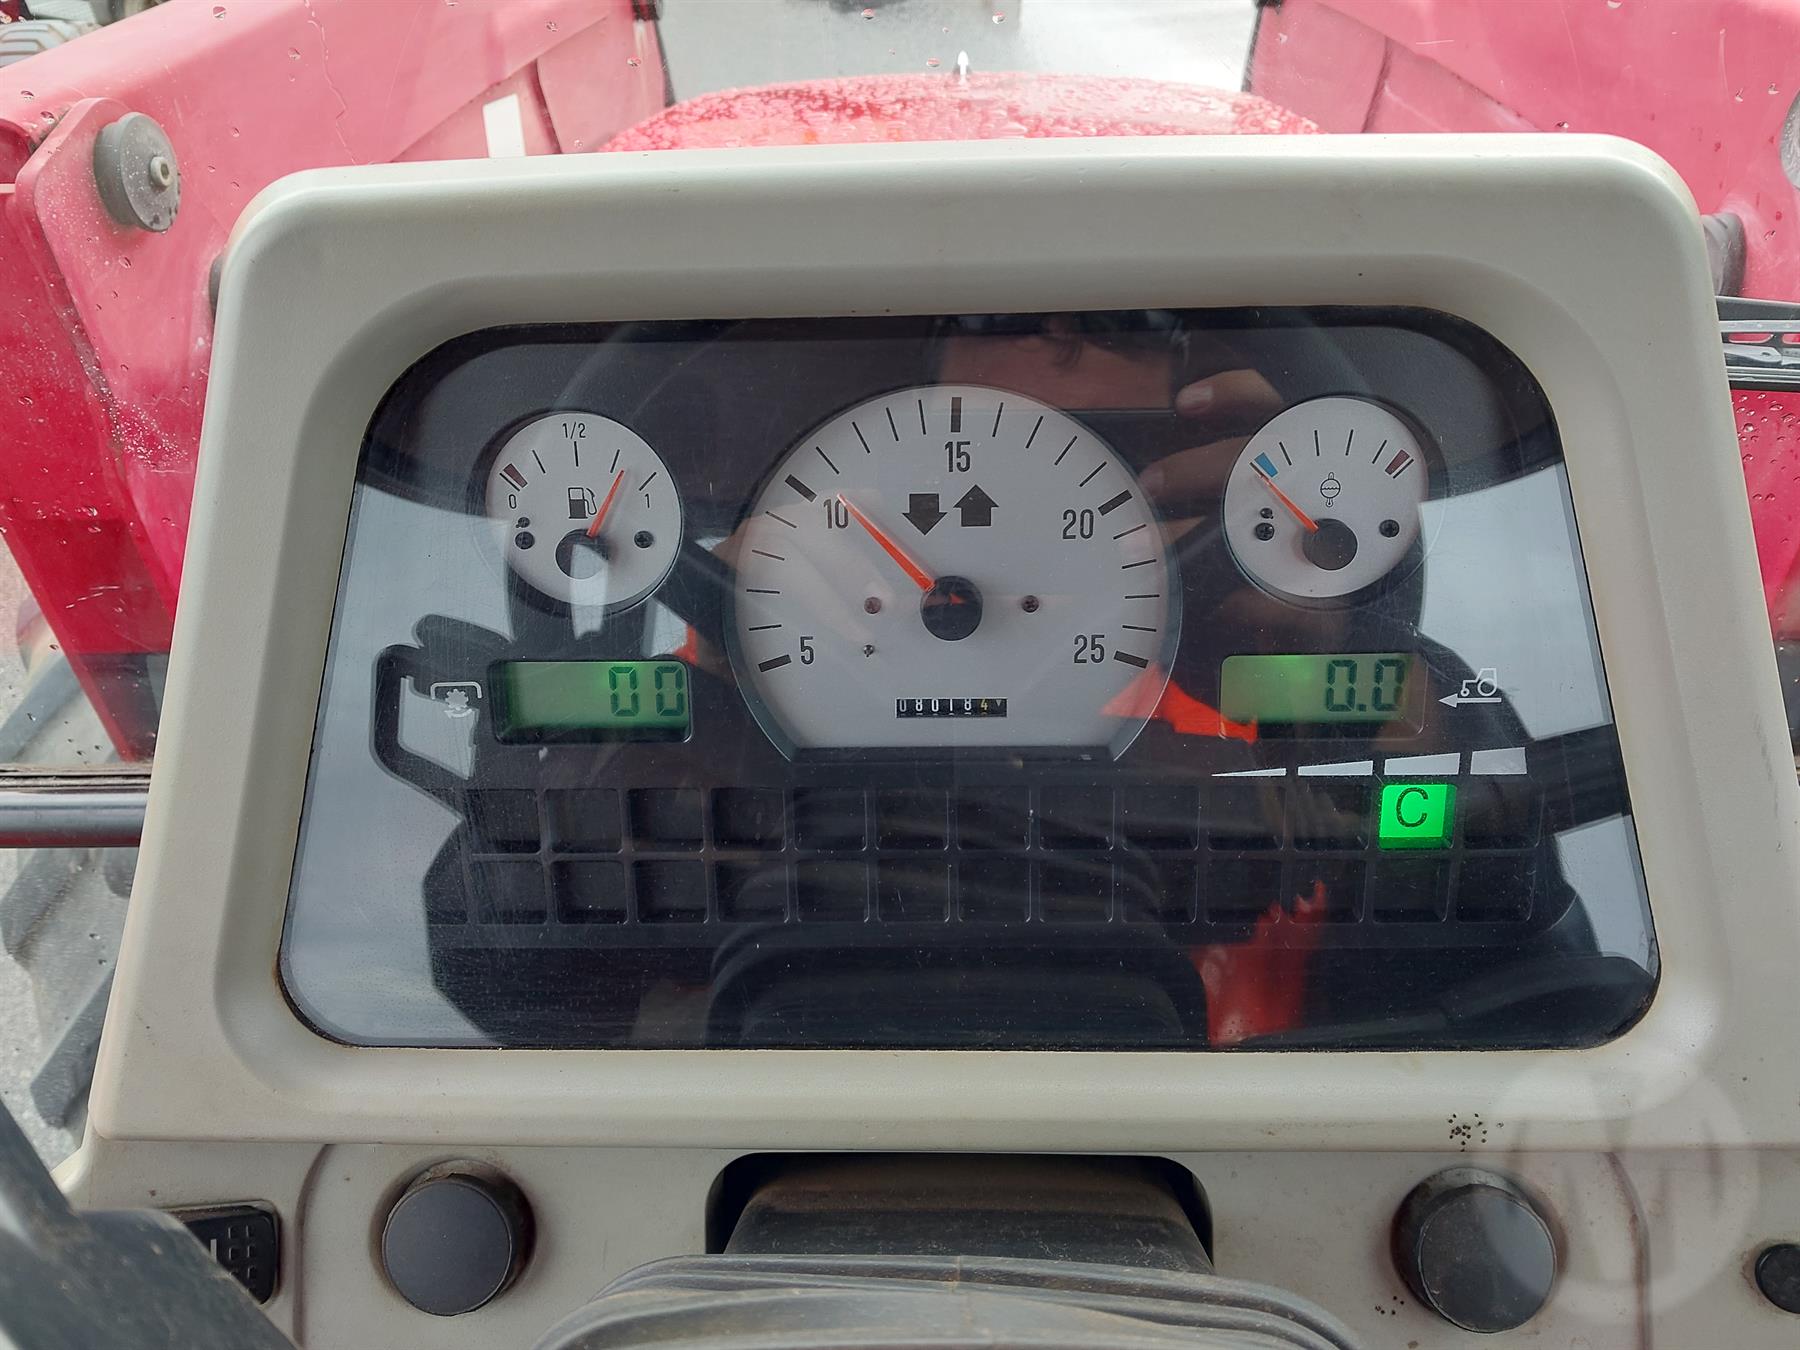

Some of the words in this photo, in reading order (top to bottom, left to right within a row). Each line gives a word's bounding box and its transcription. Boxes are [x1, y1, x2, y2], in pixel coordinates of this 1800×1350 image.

[562, 421, 586, 439] 1/2
[945, 441, 971, 473] 15
[508, 494, 517, 509] 0
[644, 493, 650, 508] 1
[823, 498, 849, 529] 10
[1062, 509, 1094, 540] 20
[800, 636, 814, 665] 5
[1073, 635, 1105, 664] 25
[608, 666, 685, 717] 00
[1325, 659, 1405, 712] 0.0
[1396, 787, 1429, 828] C
